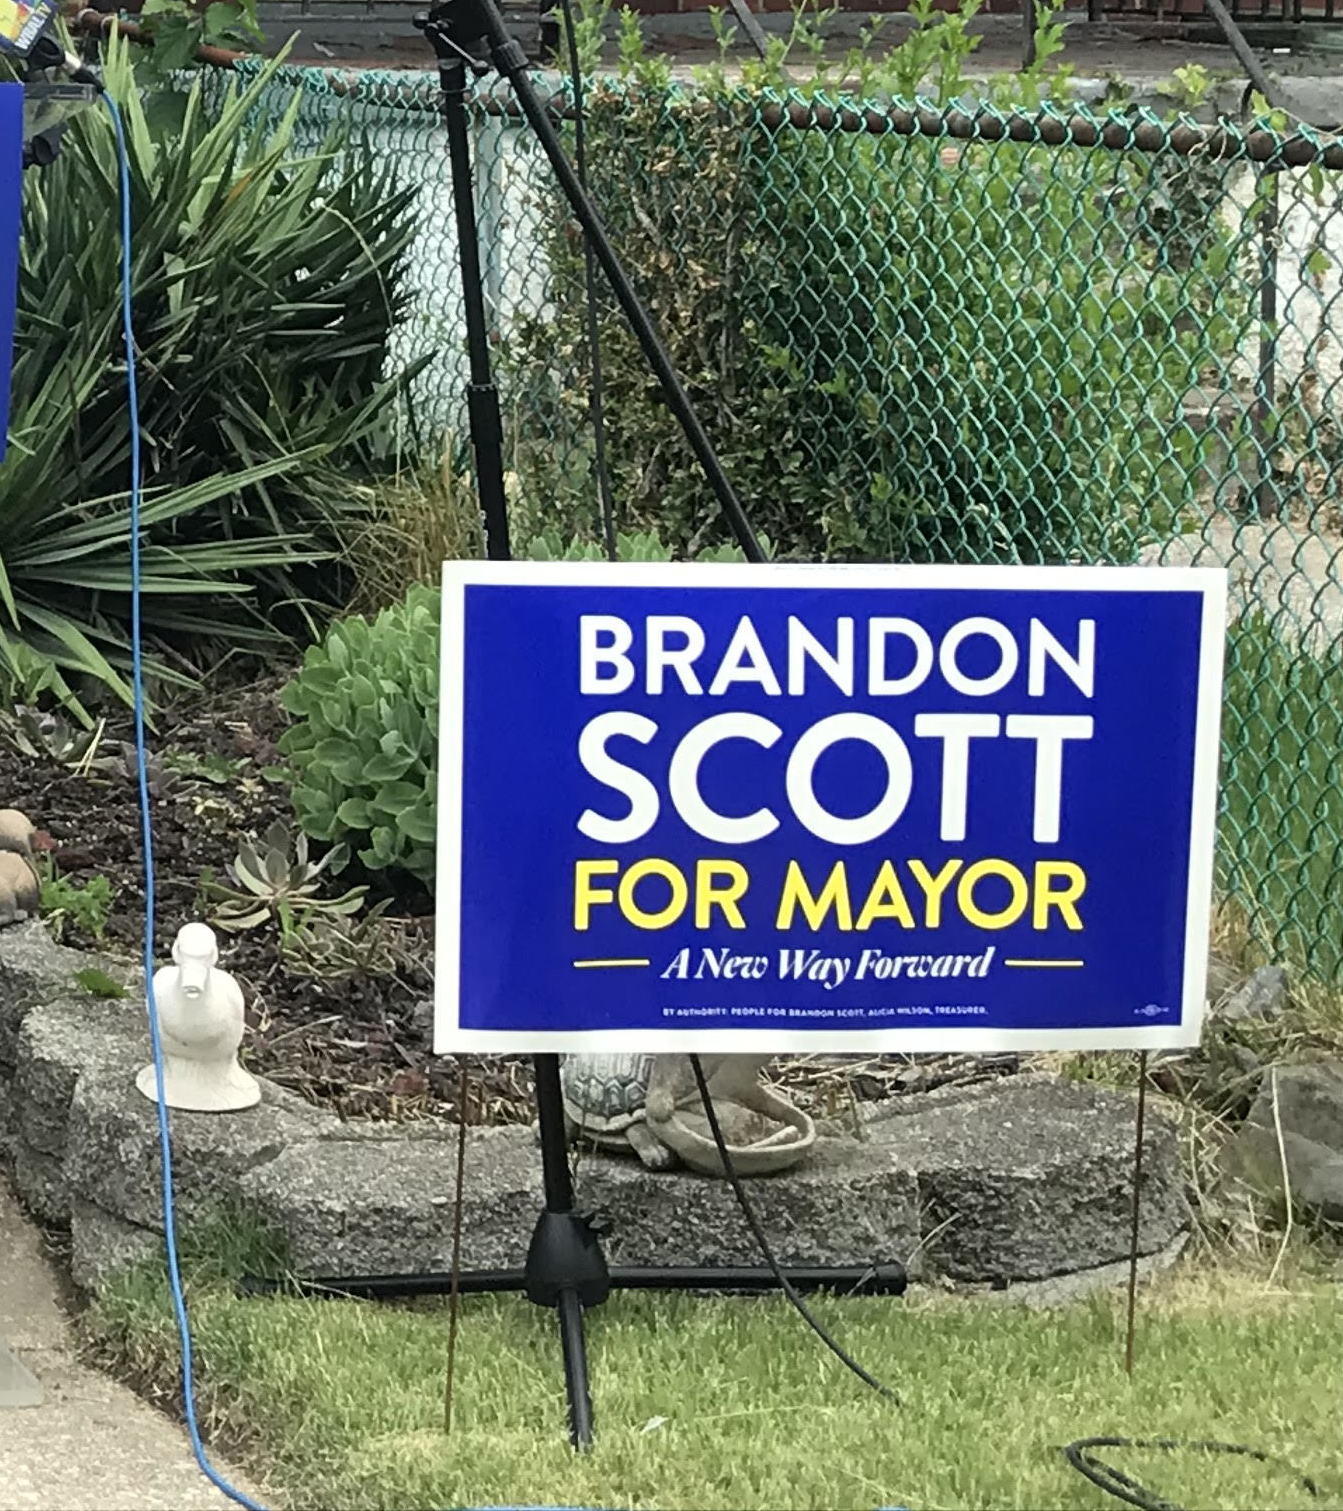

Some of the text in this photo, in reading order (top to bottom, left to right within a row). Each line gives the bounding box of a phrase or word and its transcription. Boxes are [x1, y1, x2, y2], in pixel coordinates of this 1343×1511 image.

[580, 614, 1096, 698] BRANDON
[577, 711, 1094, 846] SCOTT
[574, 858, 1087, 931] FOR MAYOR
[660, 946, 996, 990] A New Way Forward
[730, 1007, 765, 1016] PEOPLE
[767, 1008, 787, 1017] FOR
[789, 1008, 835, 1017] BRANDON
